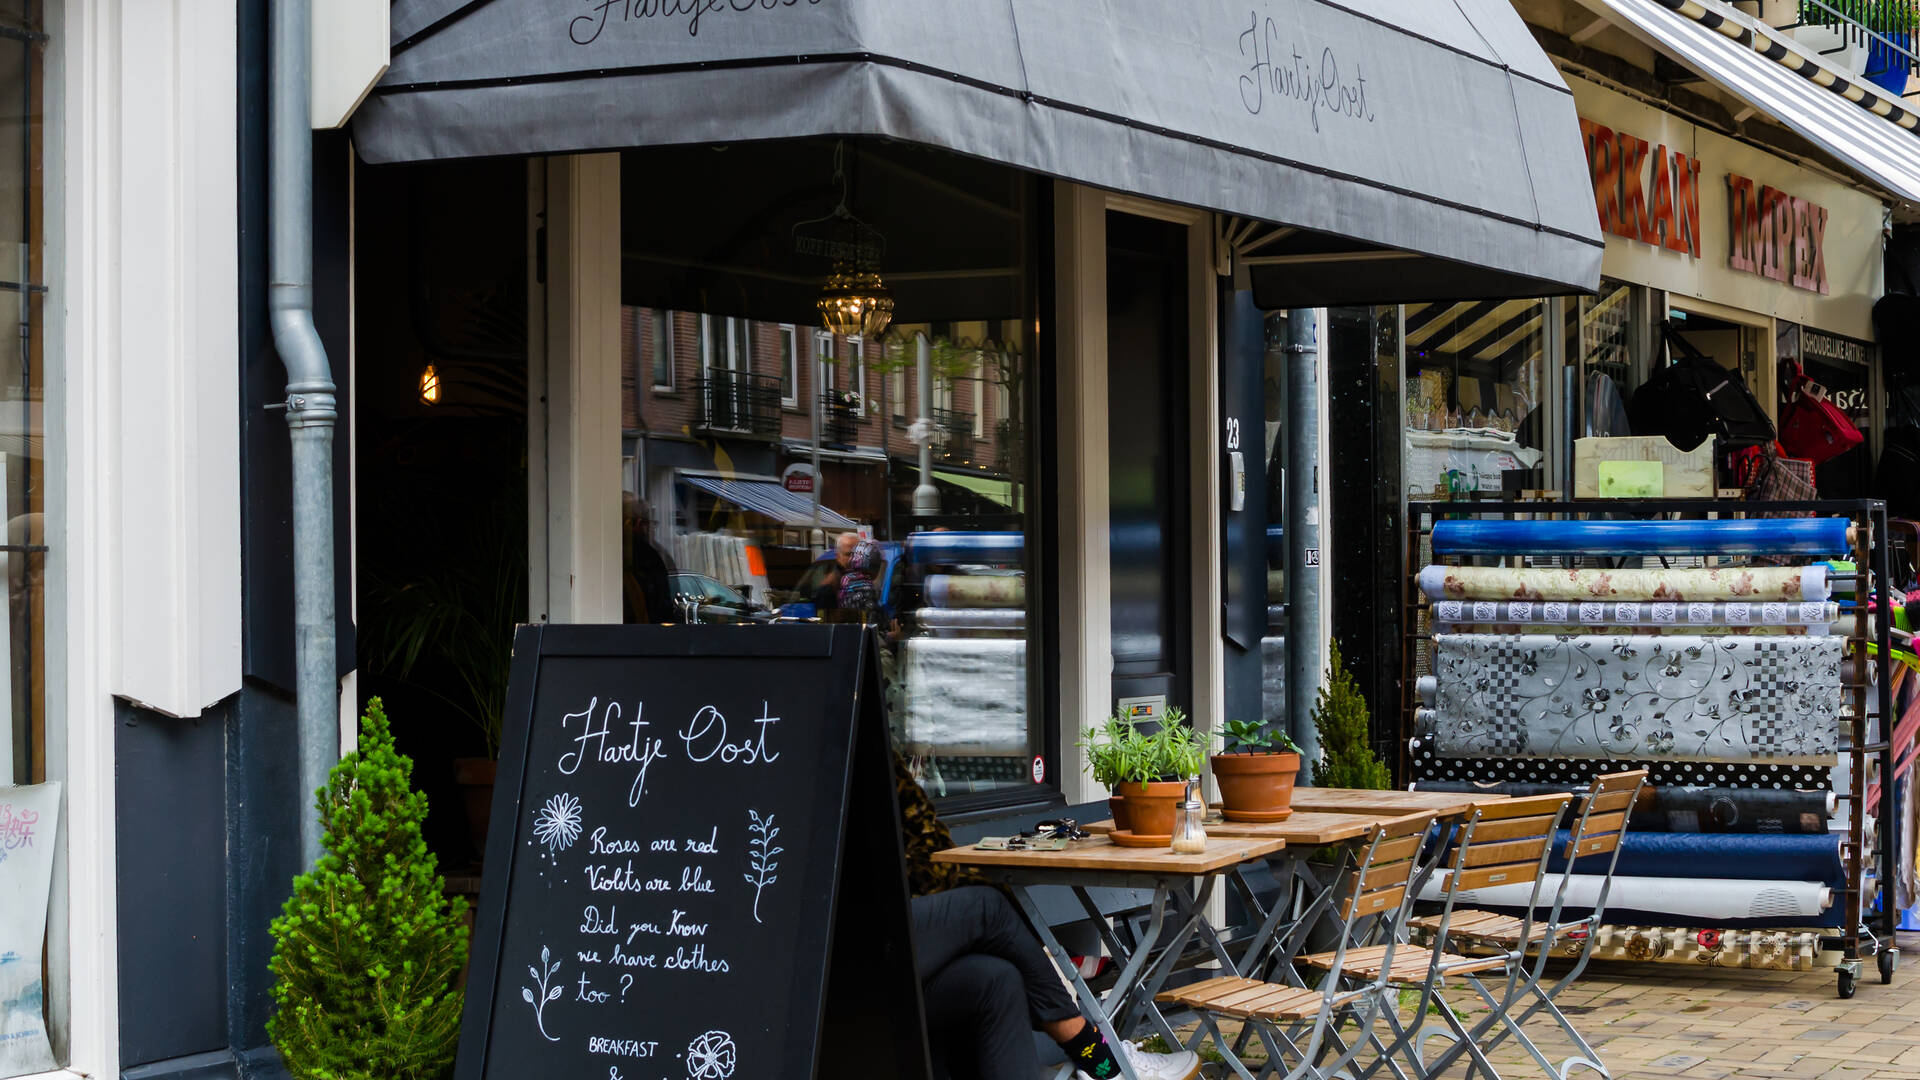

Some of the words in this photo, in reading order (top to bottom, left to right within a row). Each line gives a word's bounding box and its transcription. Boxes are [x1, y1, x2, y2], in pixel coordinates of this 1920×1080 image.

[1579, 117, 1701, 260] RKAN
[1727, 172, 1830, 296] IMPEX
[1226, 416, 1239, 450] 23
[558, 696, 667, 808] Hartje
[679, 701, 781, 764] Oost
[589, 826, 640, 854] Roses
[650, 838, 677, 852] are
[684, 826, 718, 854] red
[645, 878, 671, 891] are
[678, 866, 716, 893] blue
[580, 905, 618, 935] Did
[626, 922, 661, 945] you
[577, 950, 602, 963] we
[608, 944, 657, 969] have
[663, 943, 729, 973] clothes
[575, 971, 611, 1004] too
[589, 1036, 659, 1058] BREAKFAST
[609, 1065, 624, 1080] &
